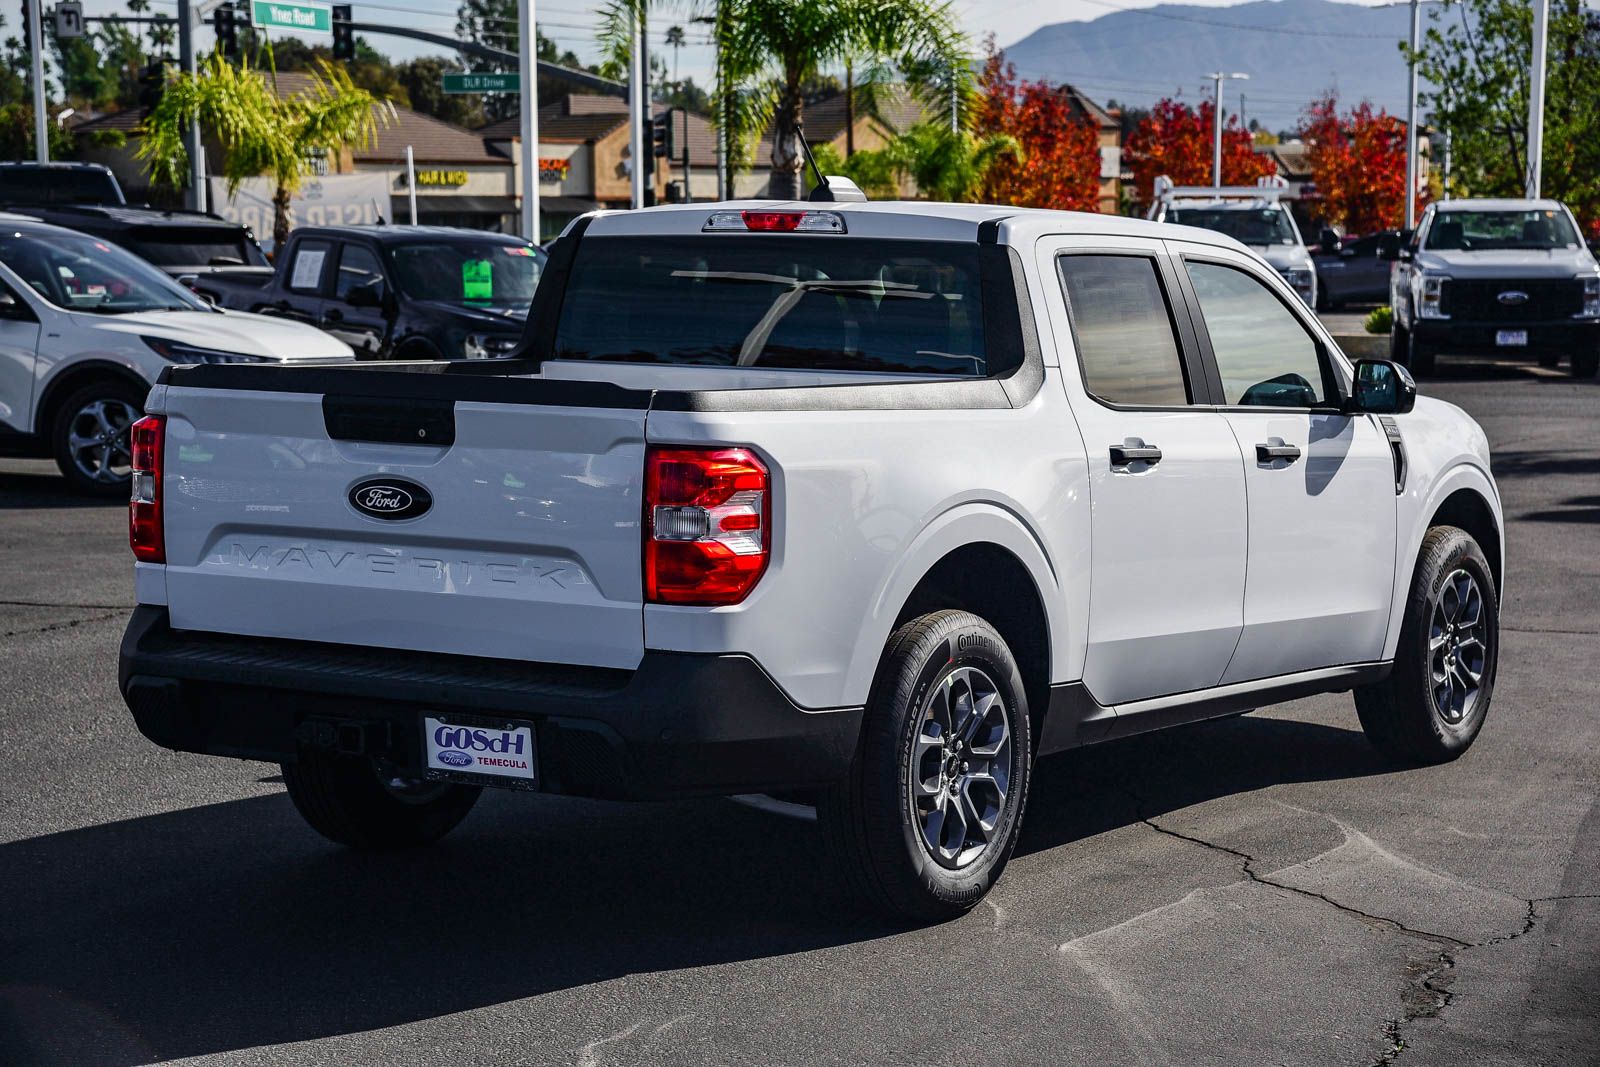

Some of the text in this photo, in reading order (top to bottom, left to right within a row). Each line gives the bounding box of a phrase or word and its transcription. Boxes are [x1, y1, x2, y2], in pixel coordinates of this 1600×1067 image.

[270, 5, 316, 26] Ynez Road
[483, 77, 505, 88] Drive
[418, 170, 439, 185] HAIR
[365, 489, 401, 508] Ford
[231, 543, 567, 590] MAVERICK
[957, 631, 1003, 658] Continental
[443, 752, 528, 769] Ford TEMECULA
